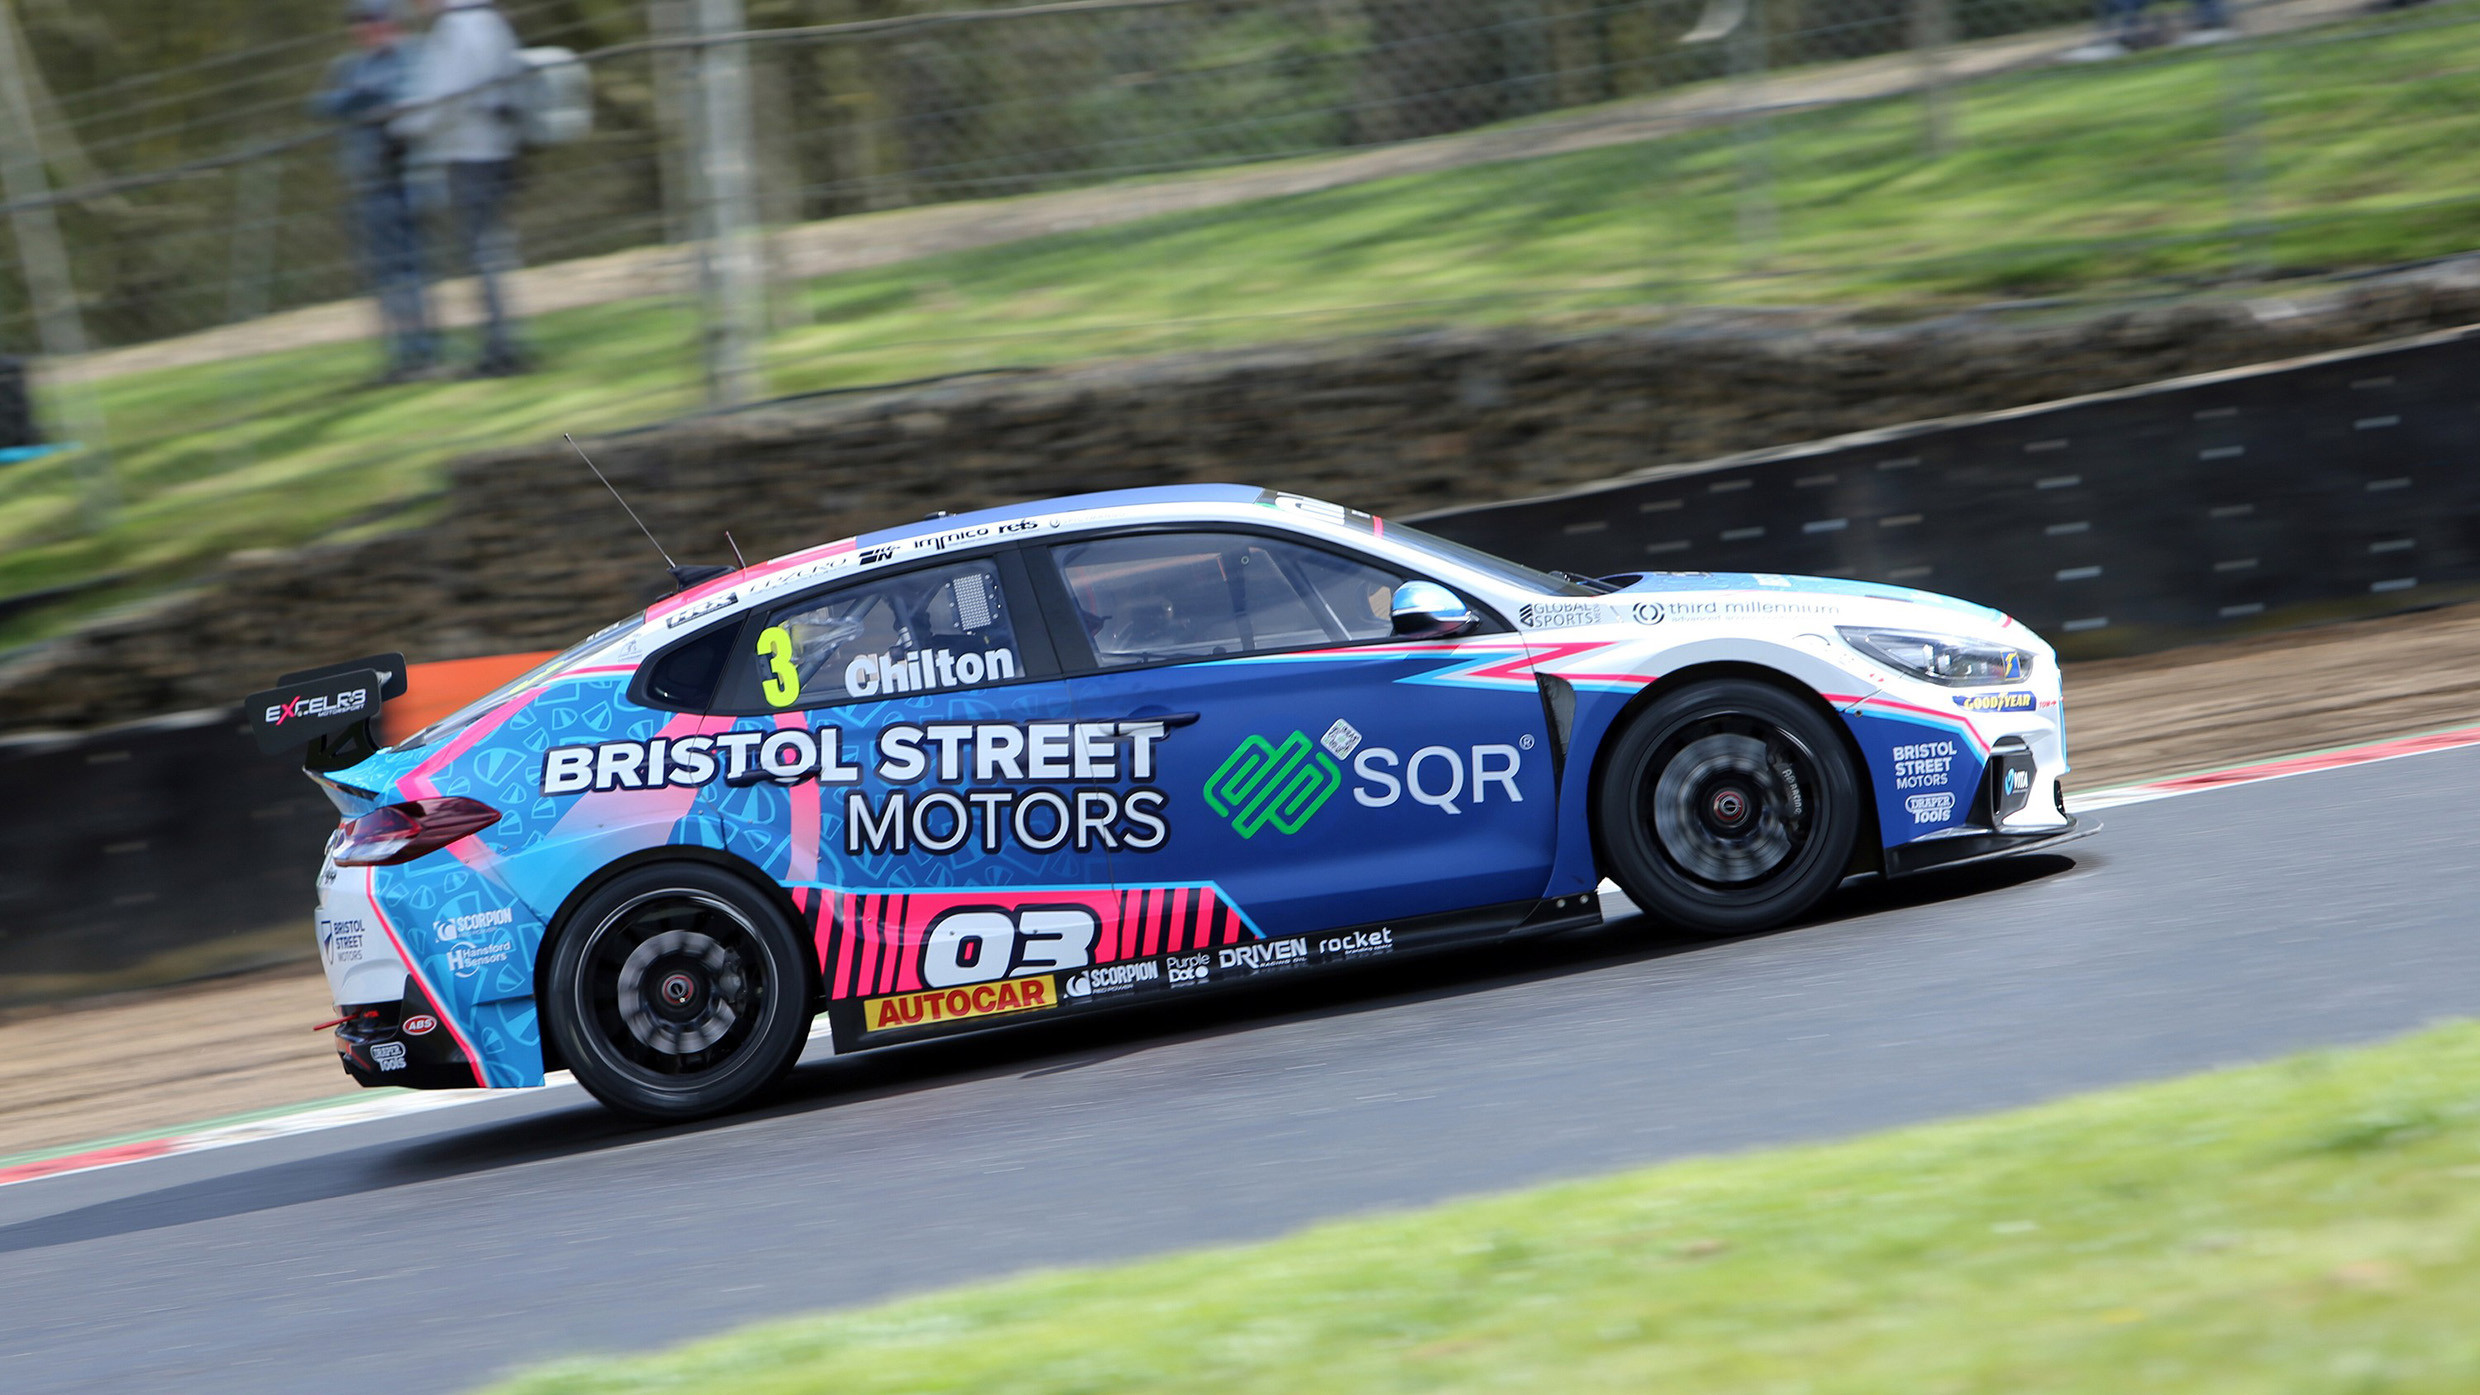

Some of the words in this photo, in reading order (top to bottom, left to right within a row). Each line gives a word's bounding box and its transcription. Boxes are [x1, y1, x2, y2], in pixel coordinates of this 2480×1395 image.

[914, 528, 989, 550] immico
[1533, 602, 1592, 614] GLOBAL
[1669, 601, 1716, 614] third
[1726, 602, 1839, 615] millennium
[1531, 612, 1594, 628] SPORTS
[757, 627, 800, 708] 3
[845, 648, 1015, 698] Chilton
[1964, 689, 2031, 711] GOODYEAR
[318, 704, 366, 718] MOTORSPORT
[543, 729, 859, 795] BRISTOL
[879, 721, 1165, 782] STREET
[1892, 741, 1957, 762] BRISTOL
[1895, 757, 1953, 777] STREET
[1896, 774, 1949, 790] MOTORS
[2013, 770, 2029, 789] VITA
[1909, 796, 1951, 810] DRAPER
[848, 790, 1166, 852] MOTORS
[334, 919, 365, 935] BRISTOL
[457, 907, 513, 932] SCORPION
[336, 935, 363, 950] STREET
[463, 941, 511, 958] Hansford
[923, 909, 1096, 989] 03
[1319, 926, 1393, 954] rocket
[337, 950, 363, 962] MOTORS
[465, 953, 508, 968] Sensors
[1167, 952, 1211, 970] Purple
[1218, 937, 1308, 970] DRIVEN
[1090, 960, 1159, 988] SCORPION
[1168, 966, 1200, 983] Dot
[877, 979, 1046, 1028] AUTOCAR
[408, 1018, 432, 1031] ABS
